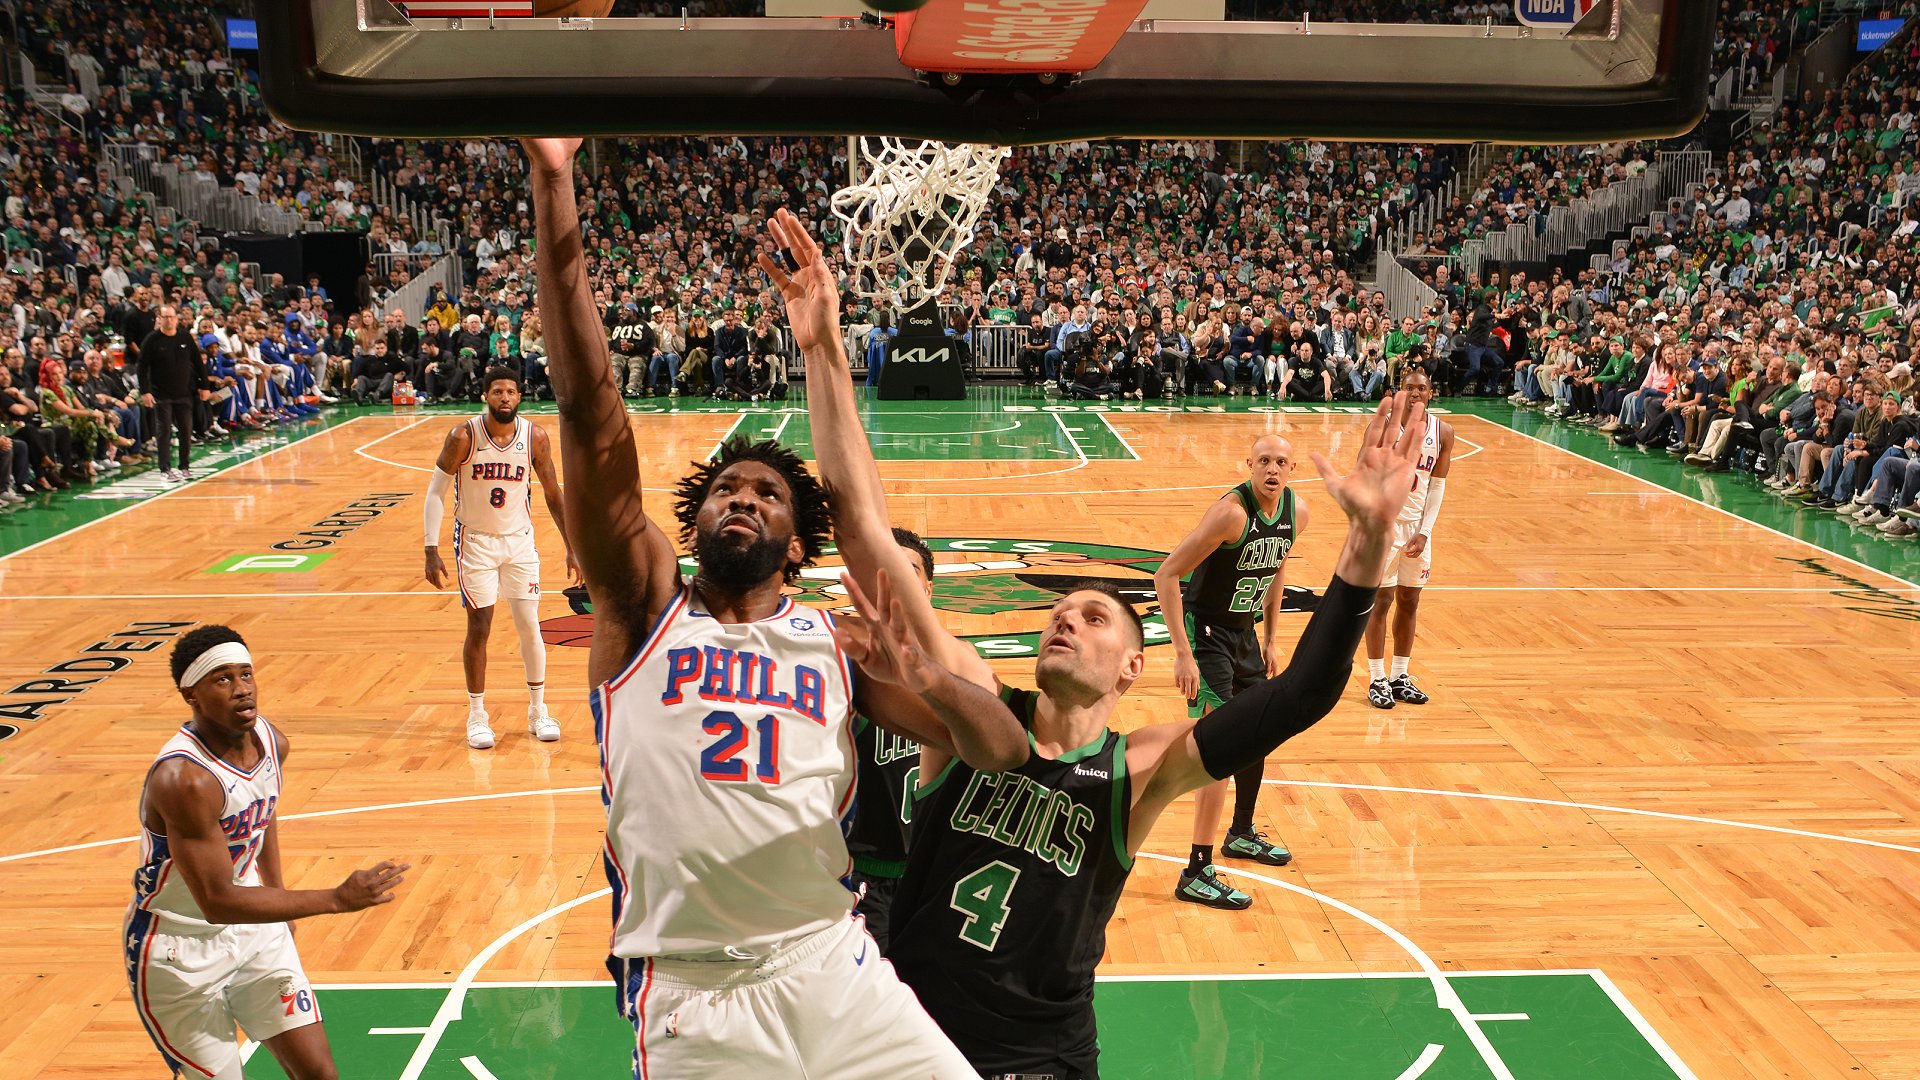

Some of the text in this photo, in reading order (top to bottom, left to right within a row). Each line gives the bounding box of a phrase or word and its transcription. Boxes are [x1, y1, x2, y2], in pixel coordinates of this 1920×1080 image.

[1527, 0, 1565, 13] NBA
[1861, 31, 1893, 40] ticketmas
[611, 324, 644, 341] BOS
[909, 317, 933, 326] Google
[891, 347, 950, 363] KIA
[1002, 405, 1226, 413] BOSTON
[471, 462, 525, 482] PHILA
[489, 487, 506, 509] 8
[270, 493, 415, 550] GARDEN
[1236, 537, 1291, 571] CELTICS
[528, 582, 539, 595] 76
[1228, 573, 1276, 612] 27
[0, 621, 201, 742] ARDEN
[661, 645, 827, 727] PHILA
[700, 710, 780, 785] 21
[1072, 763, 1108, 780] Amica
[950, 769, 1095, 877] CELTICS
[949, 860, 1021, 952] 4
[280, 989, 311, 1017] 76
